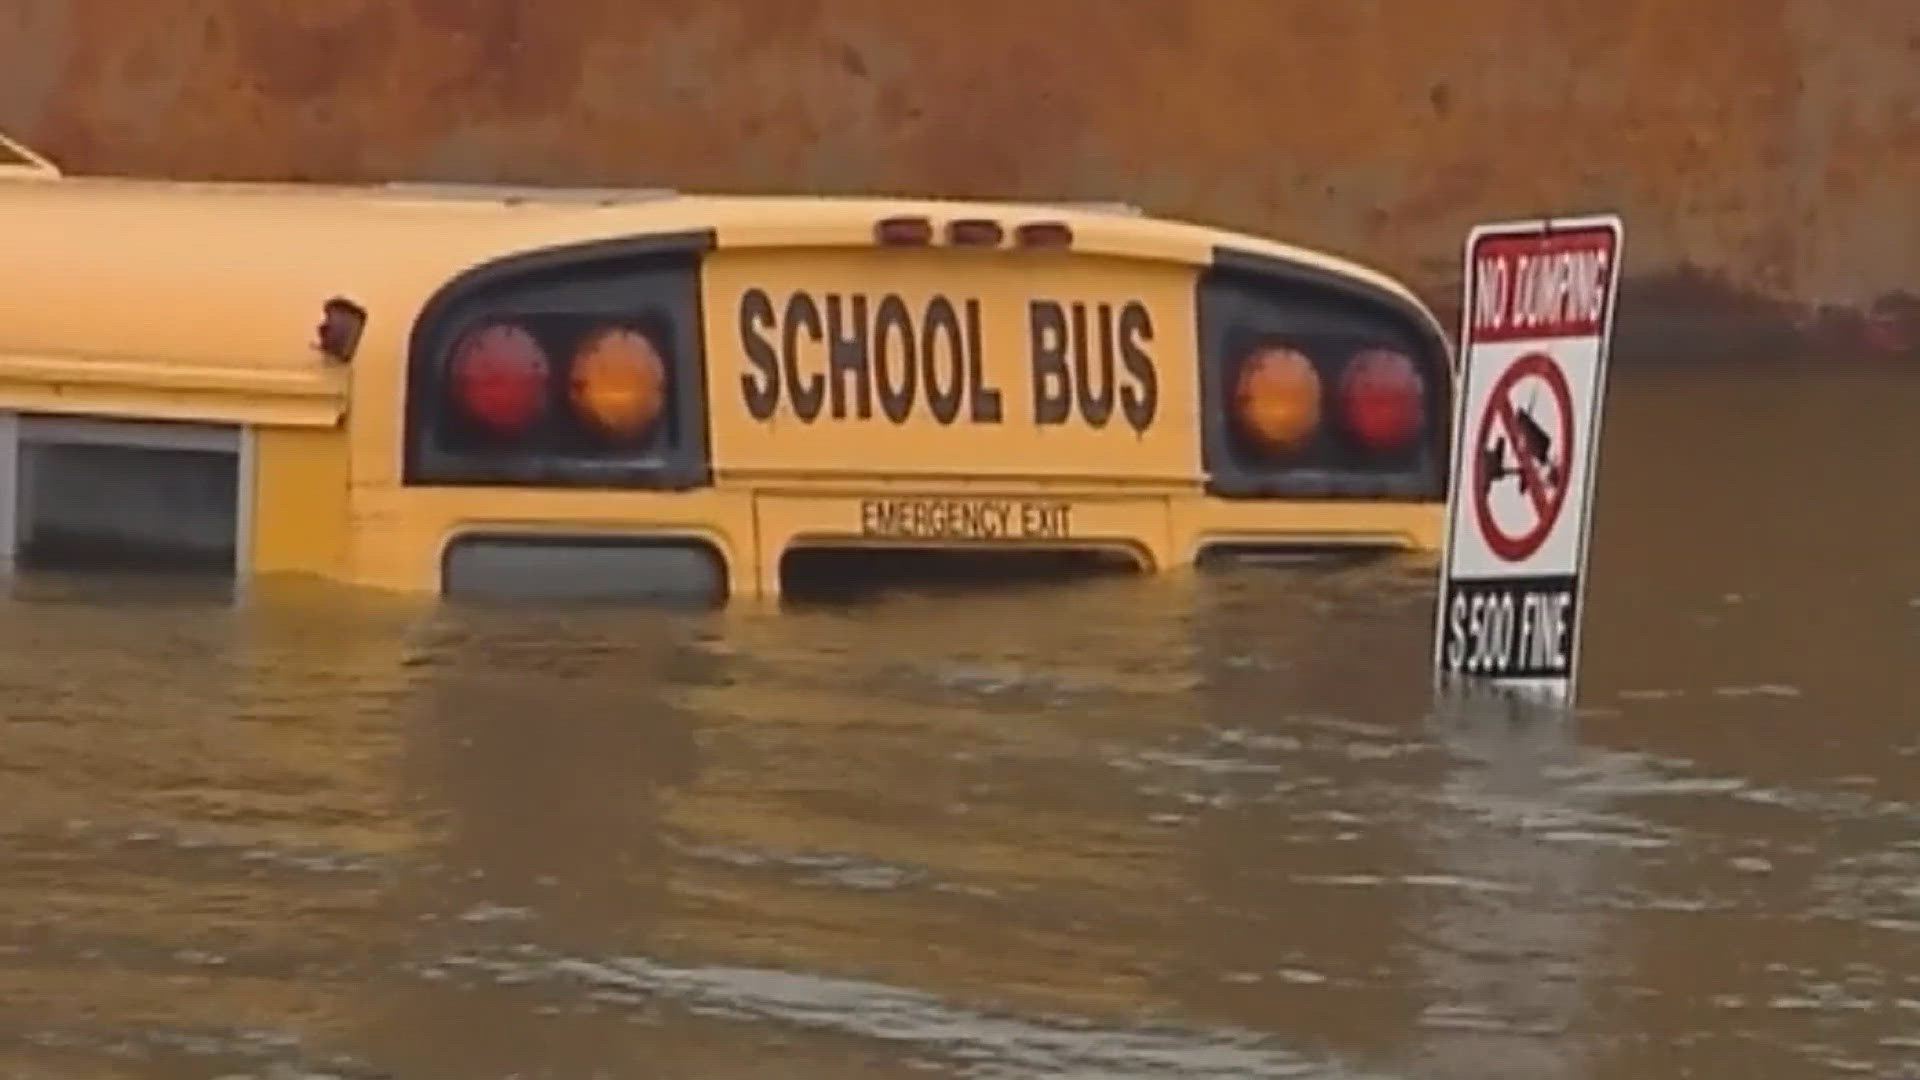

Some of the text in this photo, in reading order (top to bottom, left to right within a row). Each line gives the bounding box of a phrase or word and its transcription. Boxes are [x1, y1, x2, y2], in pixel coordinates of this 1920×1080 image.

[1475, 248, 1606, 328] NO DUMPING
[740, 288, 1157, 432] SCHOOL BUS
[862, 501, 1072, 540] EMERGENCY EXIT
[1519, 591, 1570, 670] FINE
